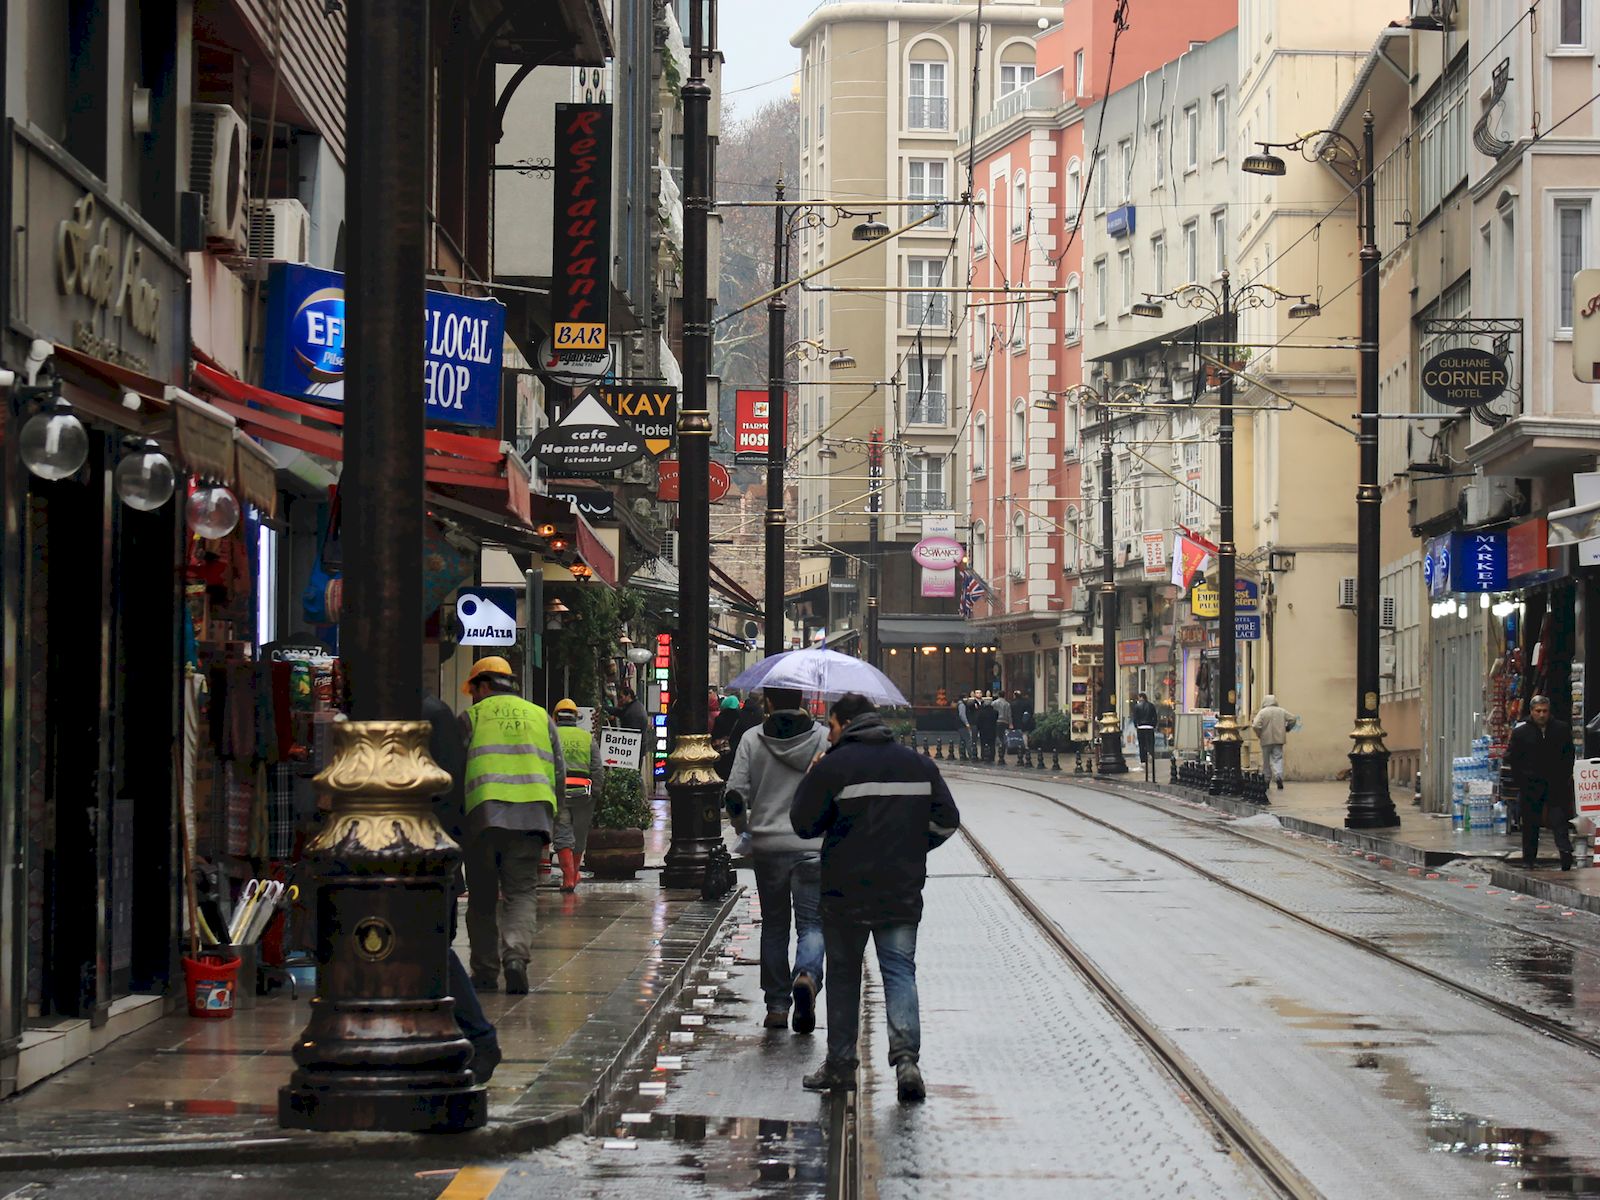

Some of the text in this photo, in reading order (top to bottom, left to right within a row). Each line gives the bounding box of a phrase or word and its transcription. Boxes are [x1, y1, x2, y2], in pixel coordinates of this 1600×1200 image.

[567, 111, 600, 319] Restaurant
[306, 309, 345, 348] EF
[557, 326, 602, 344] BAR
[430, 310, 492, 364] LOCAL
[323, 351, 344, 366] Pilse
[424, 360, 470, 409] HOP
[1425, 371, 1505, 386] CORNER
[1447, 389, 1483, 398] HOTEL
[571, 429, 608, 440] cafe
[635, 423, 673, 436] Hotel
[740, 433, 769, 446] HOST
[540, 442, 638, 454] HomeMade
[920, 546, 959, 558] ROMANCE
[1475, 535, 1495, 589] MARKET
[1235, 630, 1255, 638] LACE
[605, 733, 638, 746] Barber
[608, 745, 632, 757] Shop
[1578, 782, 1600, 791] KUA
